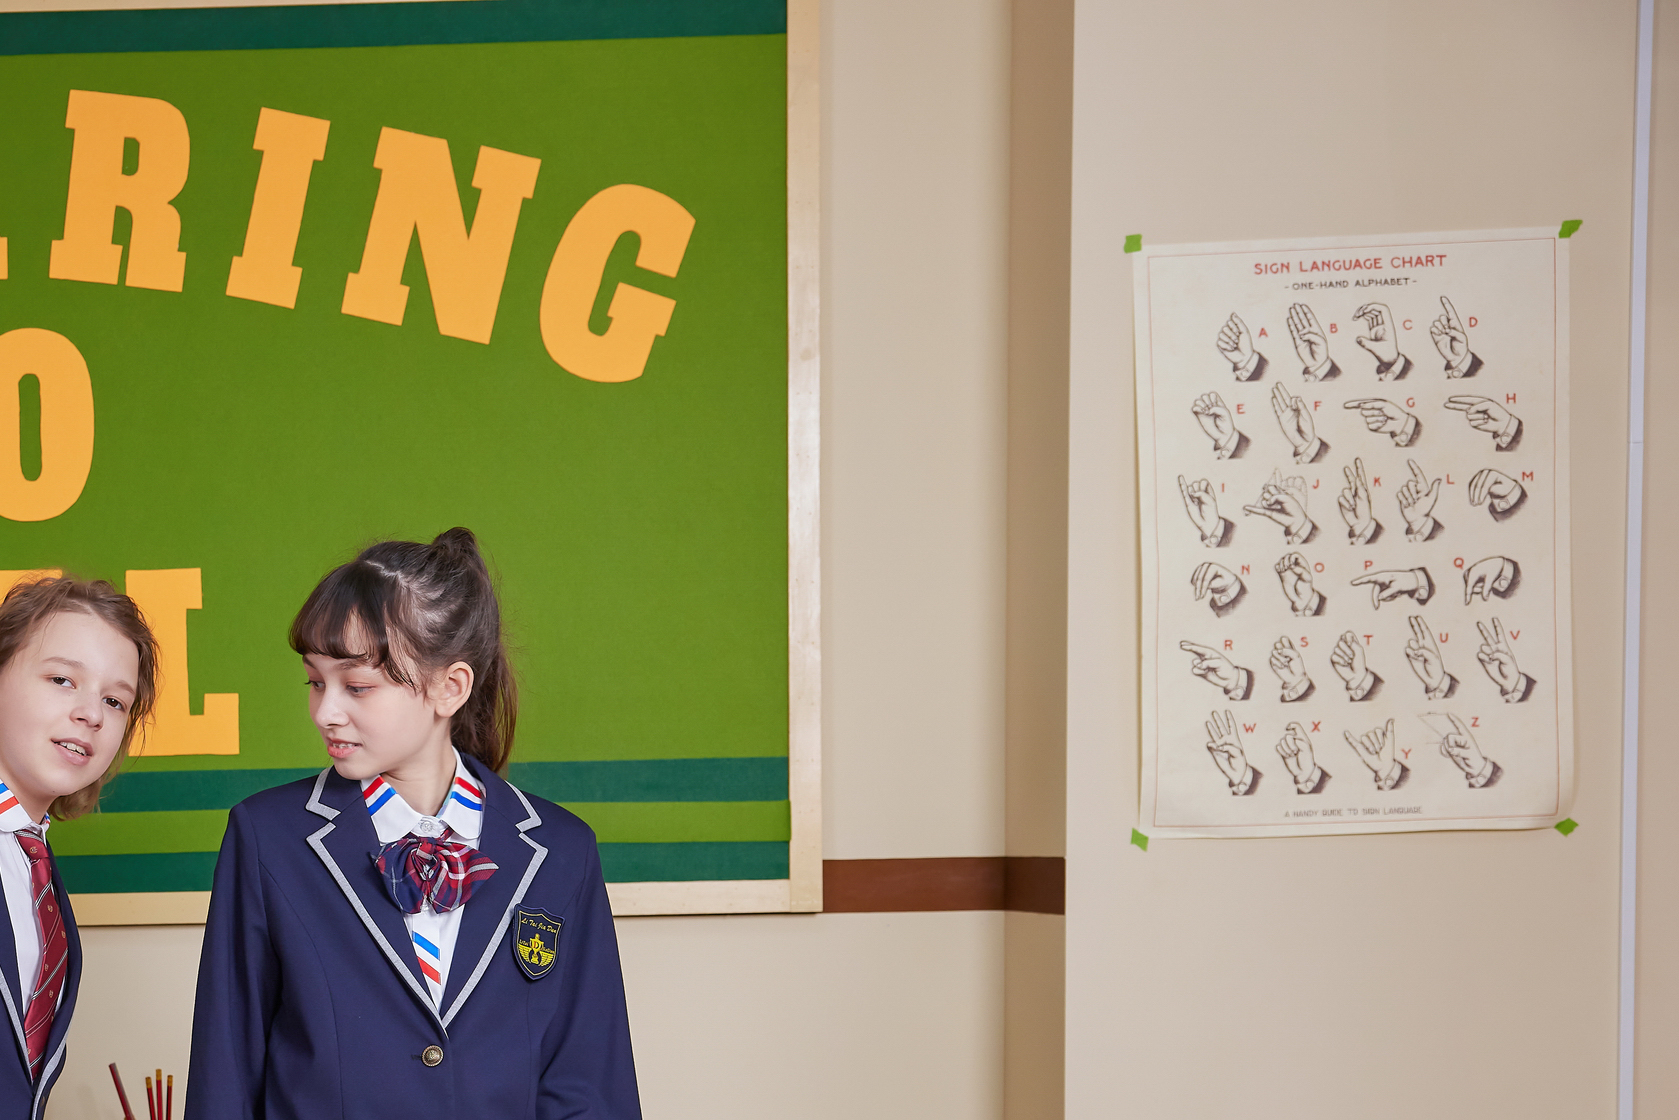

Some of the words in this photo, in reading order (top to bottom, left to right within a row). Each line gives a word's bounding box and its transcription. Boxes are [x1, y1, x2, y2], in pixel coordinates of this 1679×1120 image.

[1254, 262, 1291, 275] SIGN
[1299, 258, 1383, 273] LANGUAGE
[1390, 254, 1447, 269] CHART
[1354, 277, 1410, 287] ALPHABET
[1258, 327, 1269, 338] A
[1329, 324, 1338, 334] B
[1403, 320, 1413, 331] C
[1469, 317, 1478, 328] D
[1236, 403, 1245, 415] E
[1313, 401, 1322, 412] F
[1406, 397, 1415, 408] G
[1506, 393, 1517, 404] H
[1220, 483, 1225, 493] I
[1312, 479, 1320, 489] J
[1373, 477, 1382, 487] K
[1446, 474, 1455, 485] L
[1521, 471, 1534, 481] M
[1241, 565, 1251, 574] N
[1314, 563, 1324, 573] O
[1364, 560, 1373, 571] P
[1453, 557, 1464, 569] Q
[1224, 639, 1233, 650] R
[1300, 637, 1309, 647] S
[1363, 635, 1373, 645] T
[1439, 633, 1449, 643] U
[1509, 631, 1520, 641] V
[1243, 723, 1256, 733] W
[1311, 721, 1321, 732] X
[1402, 749, 1412, 759] Y
[1471, 717, 1479, 727] Z
